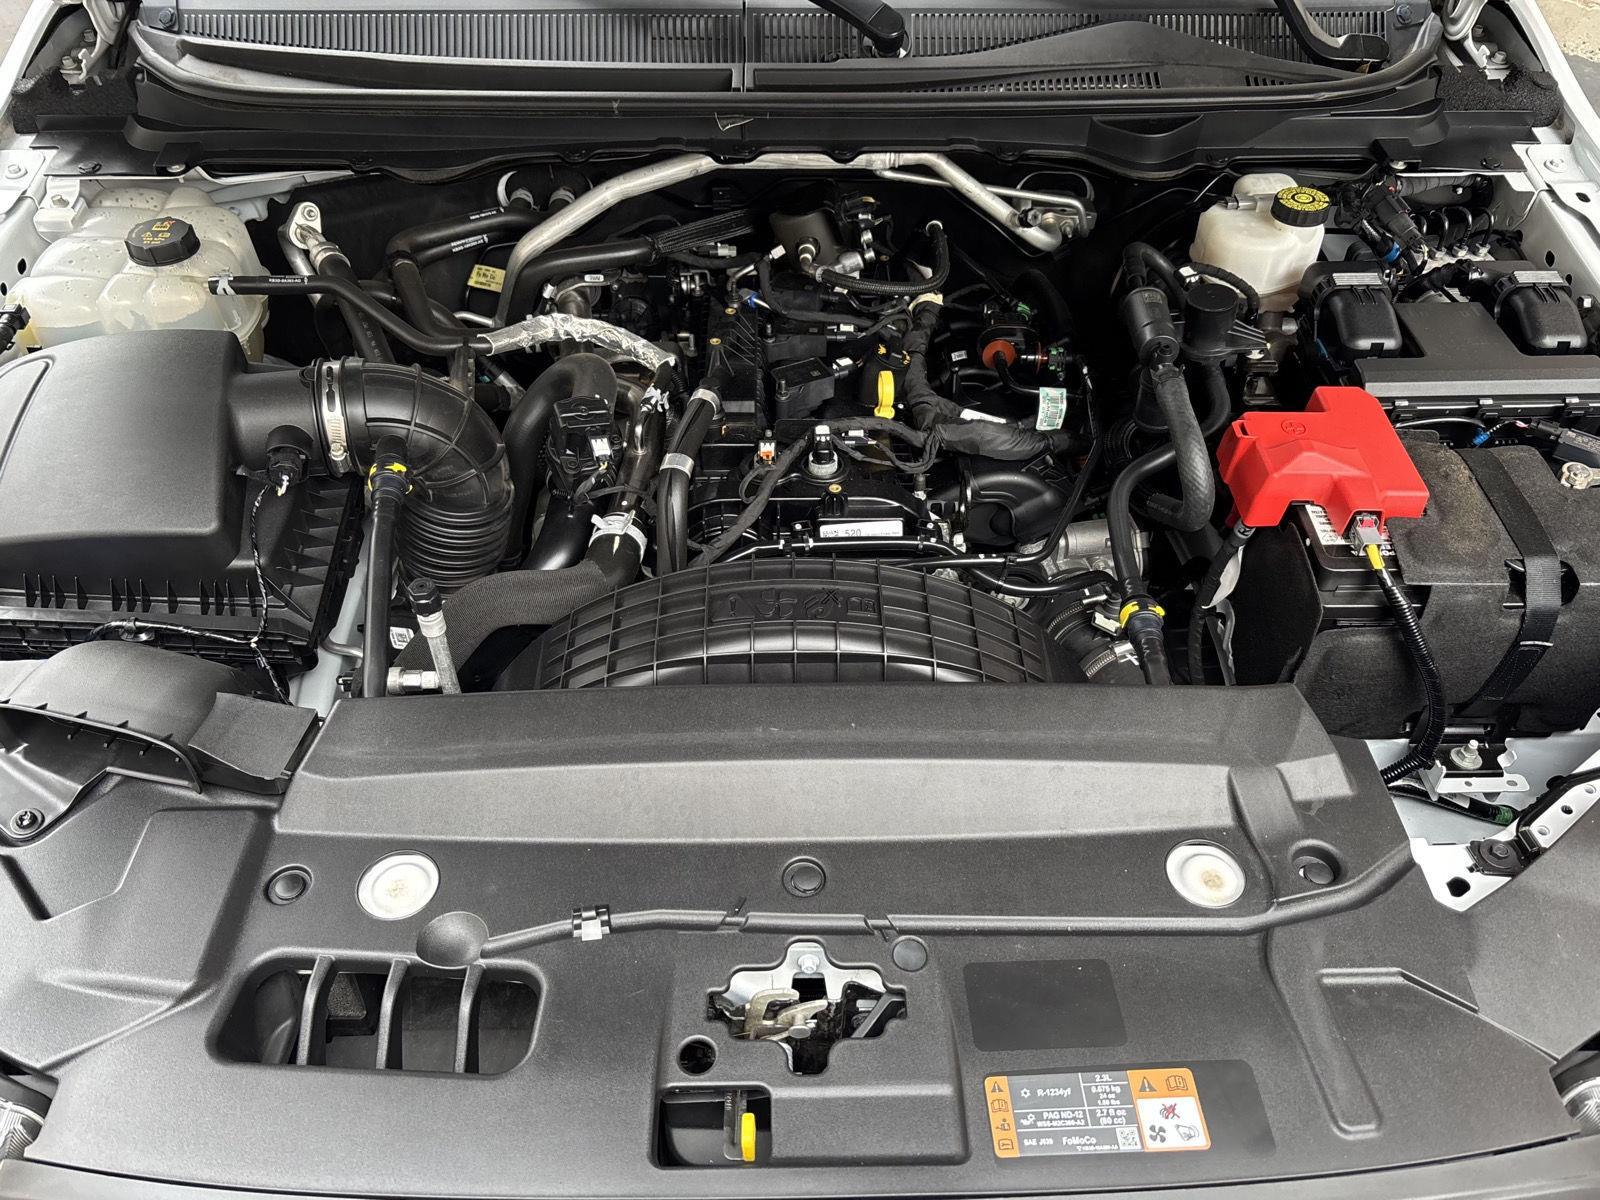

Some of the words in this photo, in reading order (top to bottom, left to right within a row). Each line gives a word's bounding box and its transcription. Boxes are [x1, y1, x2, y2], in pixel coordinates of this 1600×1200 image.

[1095, 1074, 1112, 1082] 2.3L
[1037, 1087, 1072, 1097] R-1234yf
[1043, 1111, 1060, 1119] PAG
[1061, 1110, 1084, 1119] ND-12
[1096, 1109, 1108, 1117] 2.7
[1062, 1136, 1097, 1145] FoMoCo
